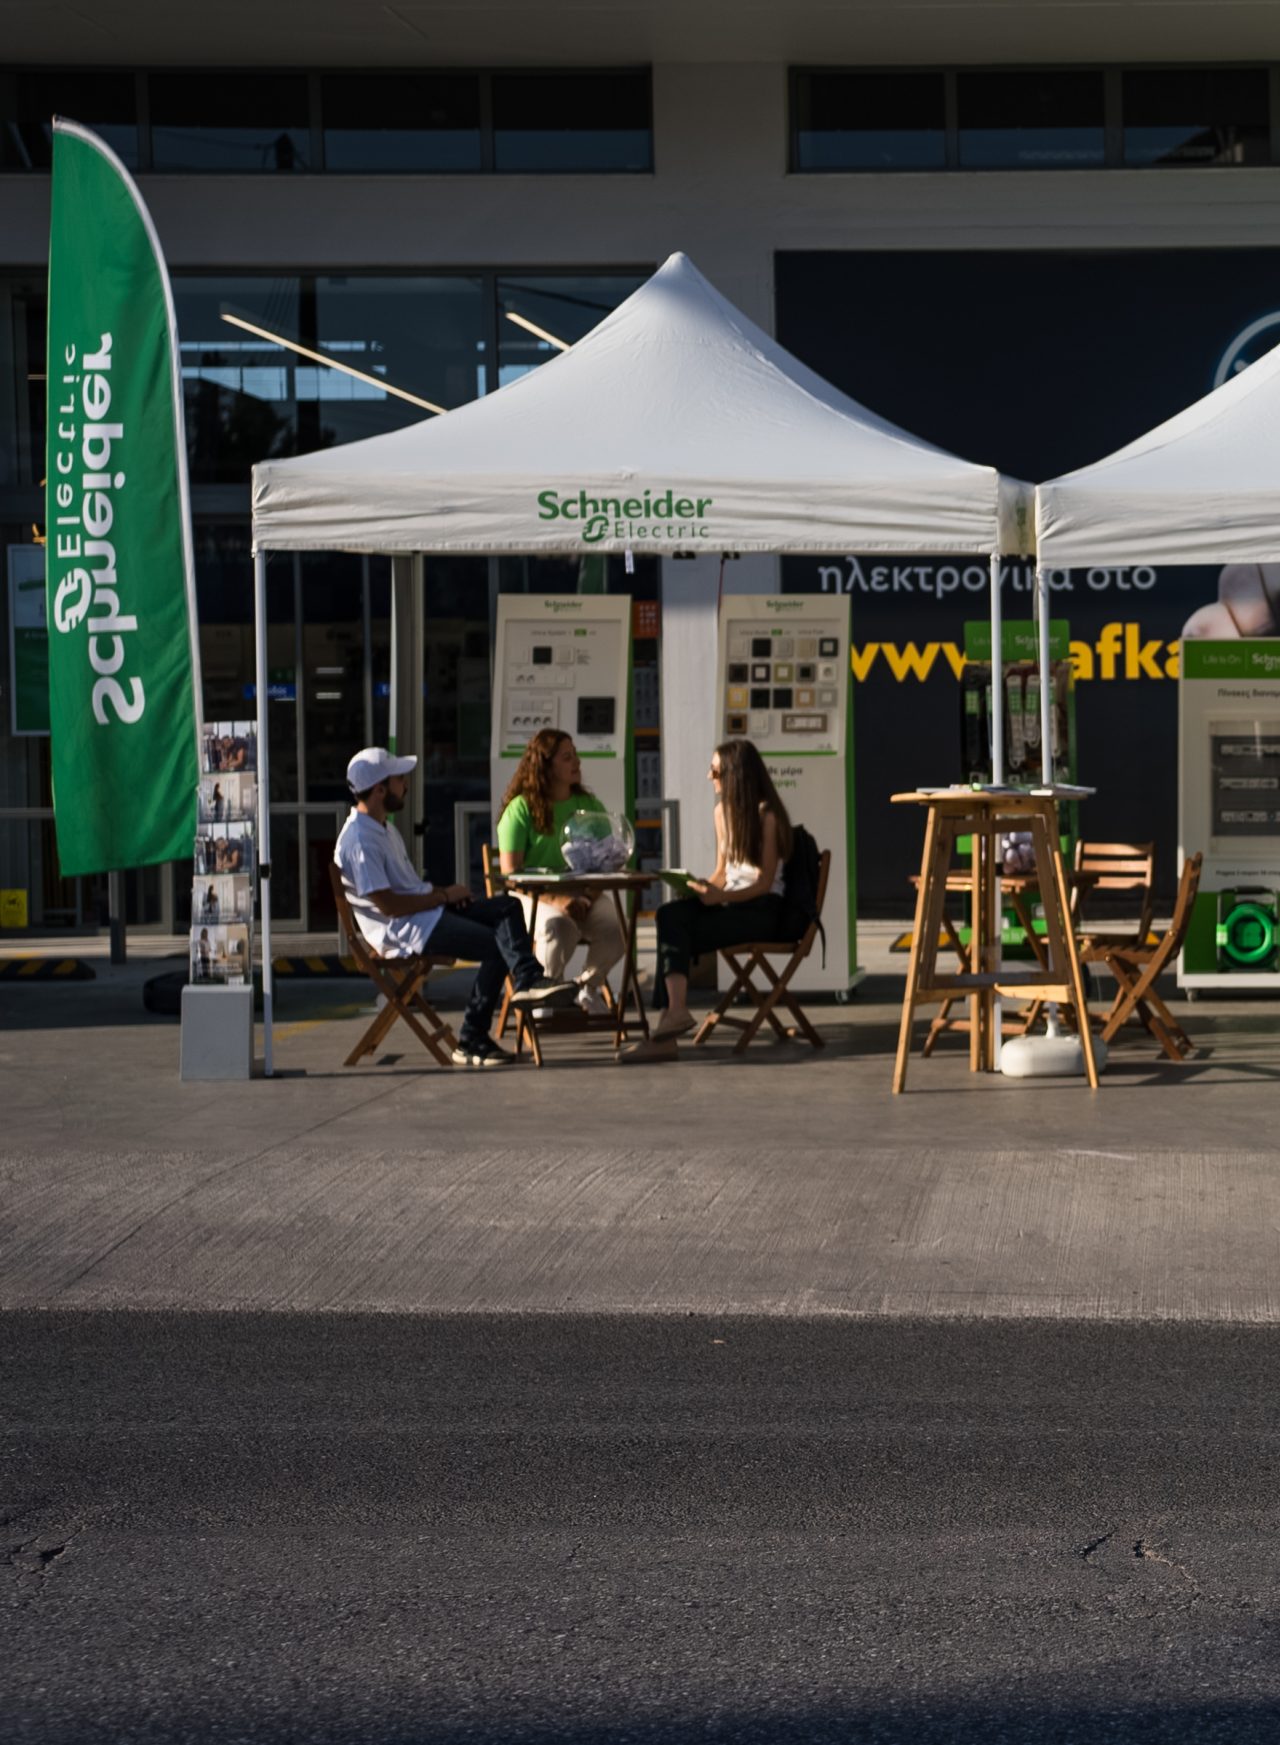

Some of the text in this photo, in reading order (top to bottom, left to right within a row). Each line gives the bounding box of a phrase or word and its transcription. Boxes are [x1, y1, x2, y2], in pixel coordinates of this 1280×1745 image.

[537, 489, 712, 520] Schneider
[614, 521, 710, 539] Electric
[1086, 565, 1157, 591] στο
